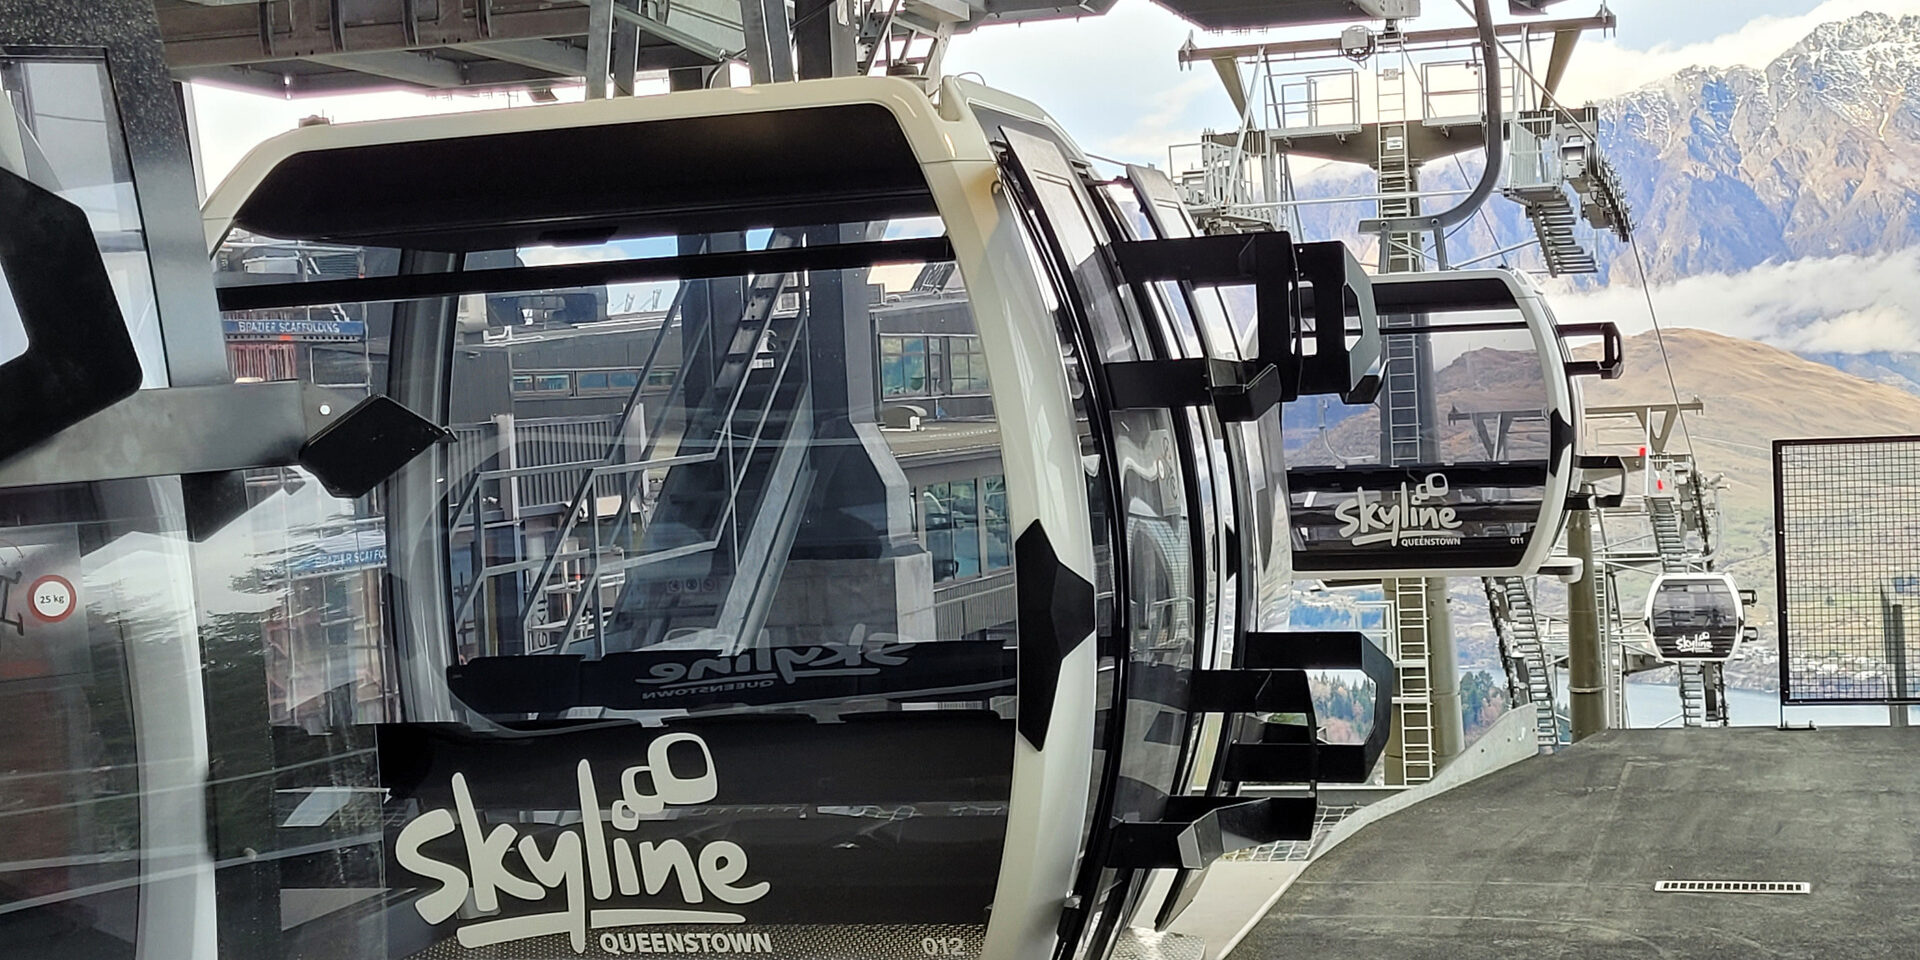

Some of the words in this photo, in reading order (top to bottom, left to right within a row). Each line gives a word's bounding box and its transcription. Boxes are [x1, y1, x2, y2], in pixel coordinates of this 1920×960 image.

[1401, 537, 1461, 547] QUEENSTOWN
[1510, 536, 1525, 545] 011
[40, 595, 52, 604] 25
[53, 594, 65, 604] kg
[395, 733, 771, 954] Skyline
[600, 932, 773, 954] QUEENSTOWN
[921, 937, 966, 956] 012
